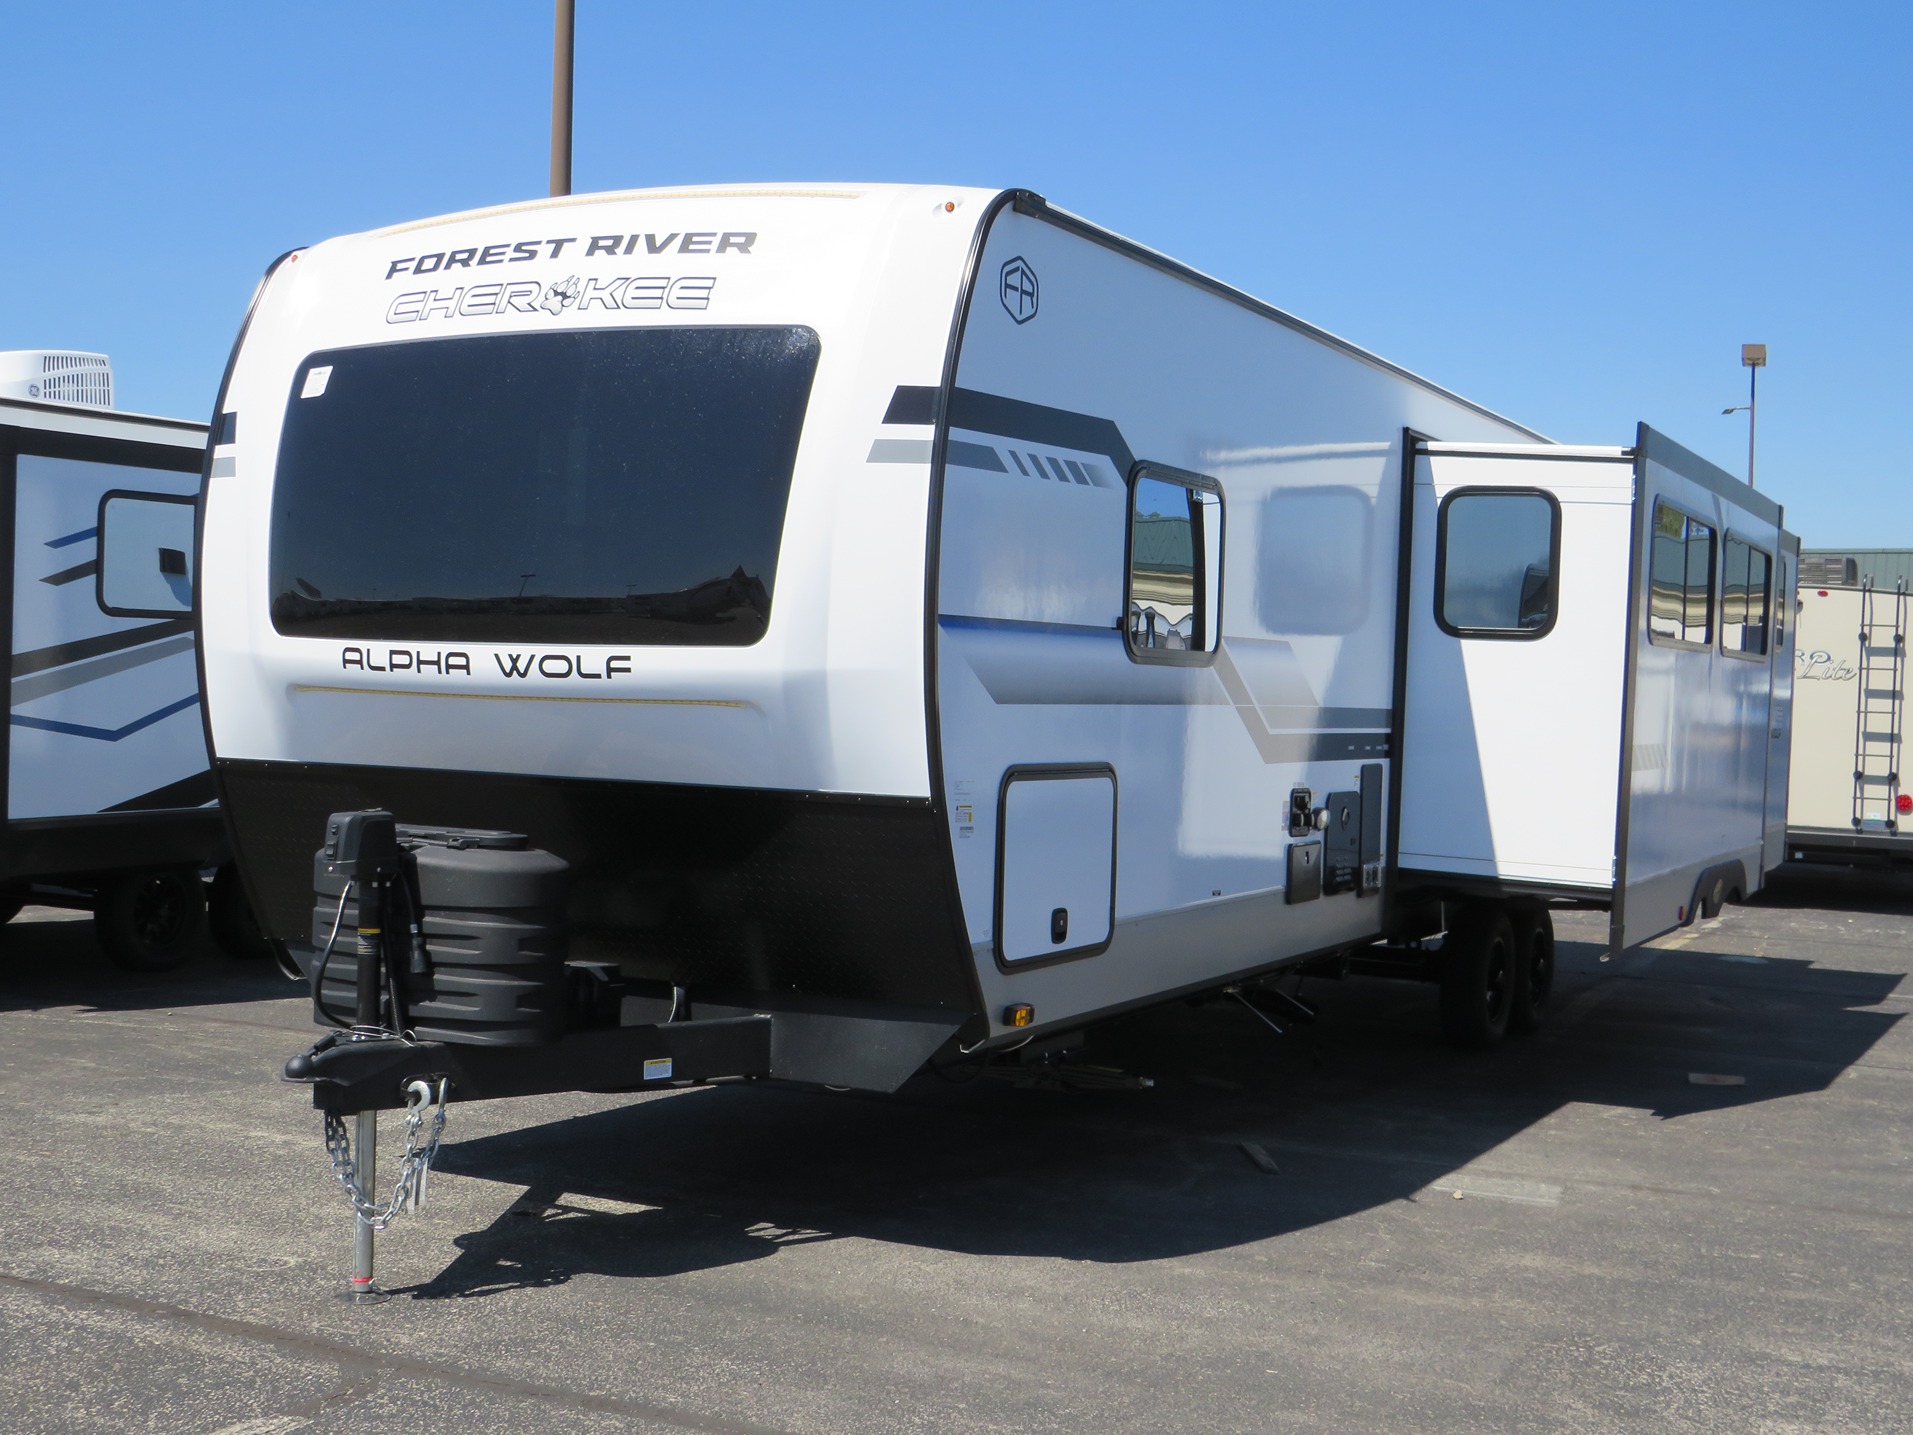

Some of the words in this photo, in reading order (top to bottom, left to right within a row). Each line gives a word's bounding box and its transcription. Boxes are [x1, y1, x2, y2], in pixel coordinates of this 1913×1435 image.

[385, 237, 578, 280] FOREST
[584, 231, 758, 257] RIVER
[342, 646, 471, 676] ALPHA
[494, 653, 632, 680] WOLF
[1796, 650, 1857, 681] Lite
